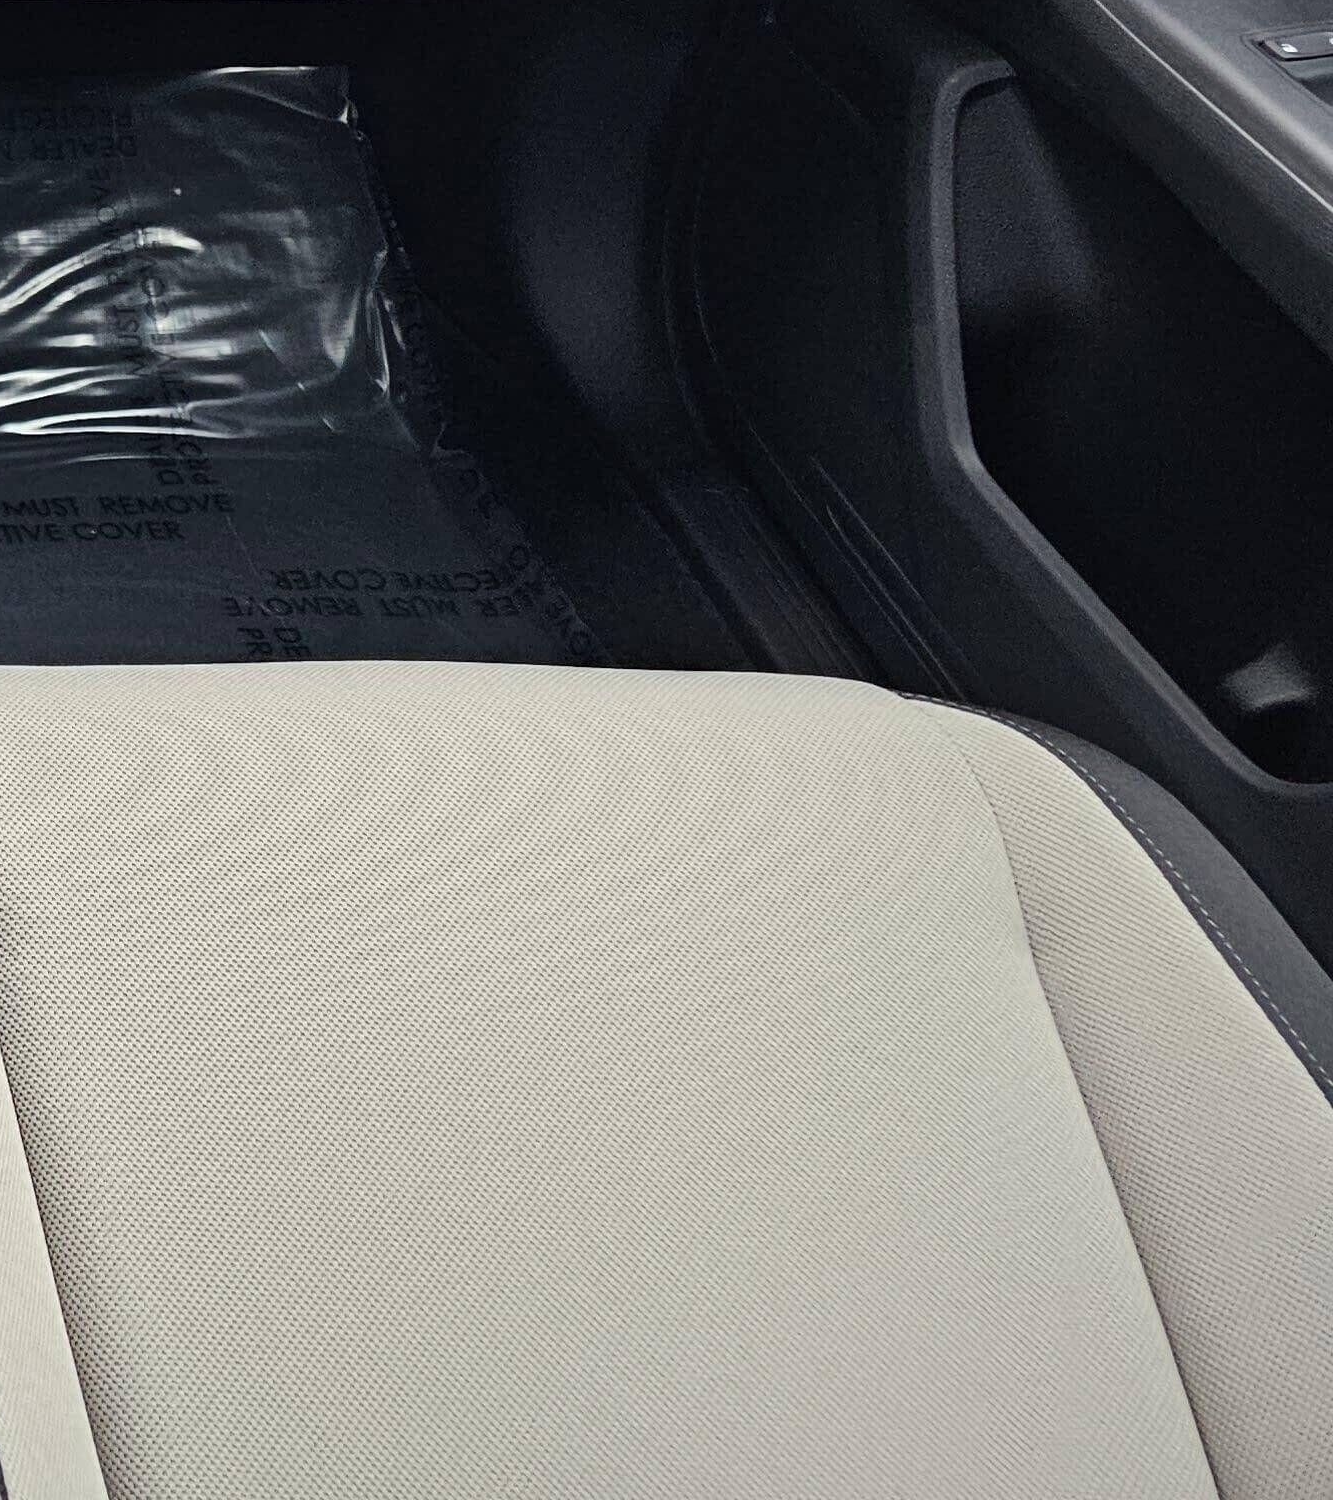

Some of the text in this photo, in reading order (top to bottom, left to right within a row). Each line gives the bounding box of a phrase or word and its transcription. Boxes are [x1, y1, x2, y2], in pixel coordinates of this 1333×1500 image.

[0, 496, 81, 518] MUST
[97, 494, 235, 516] REMOVE
[71, 520, 186, 543] COVER
[272, 569, 386, 591] COVER
[220, 596, 363, 618] REMOVE
